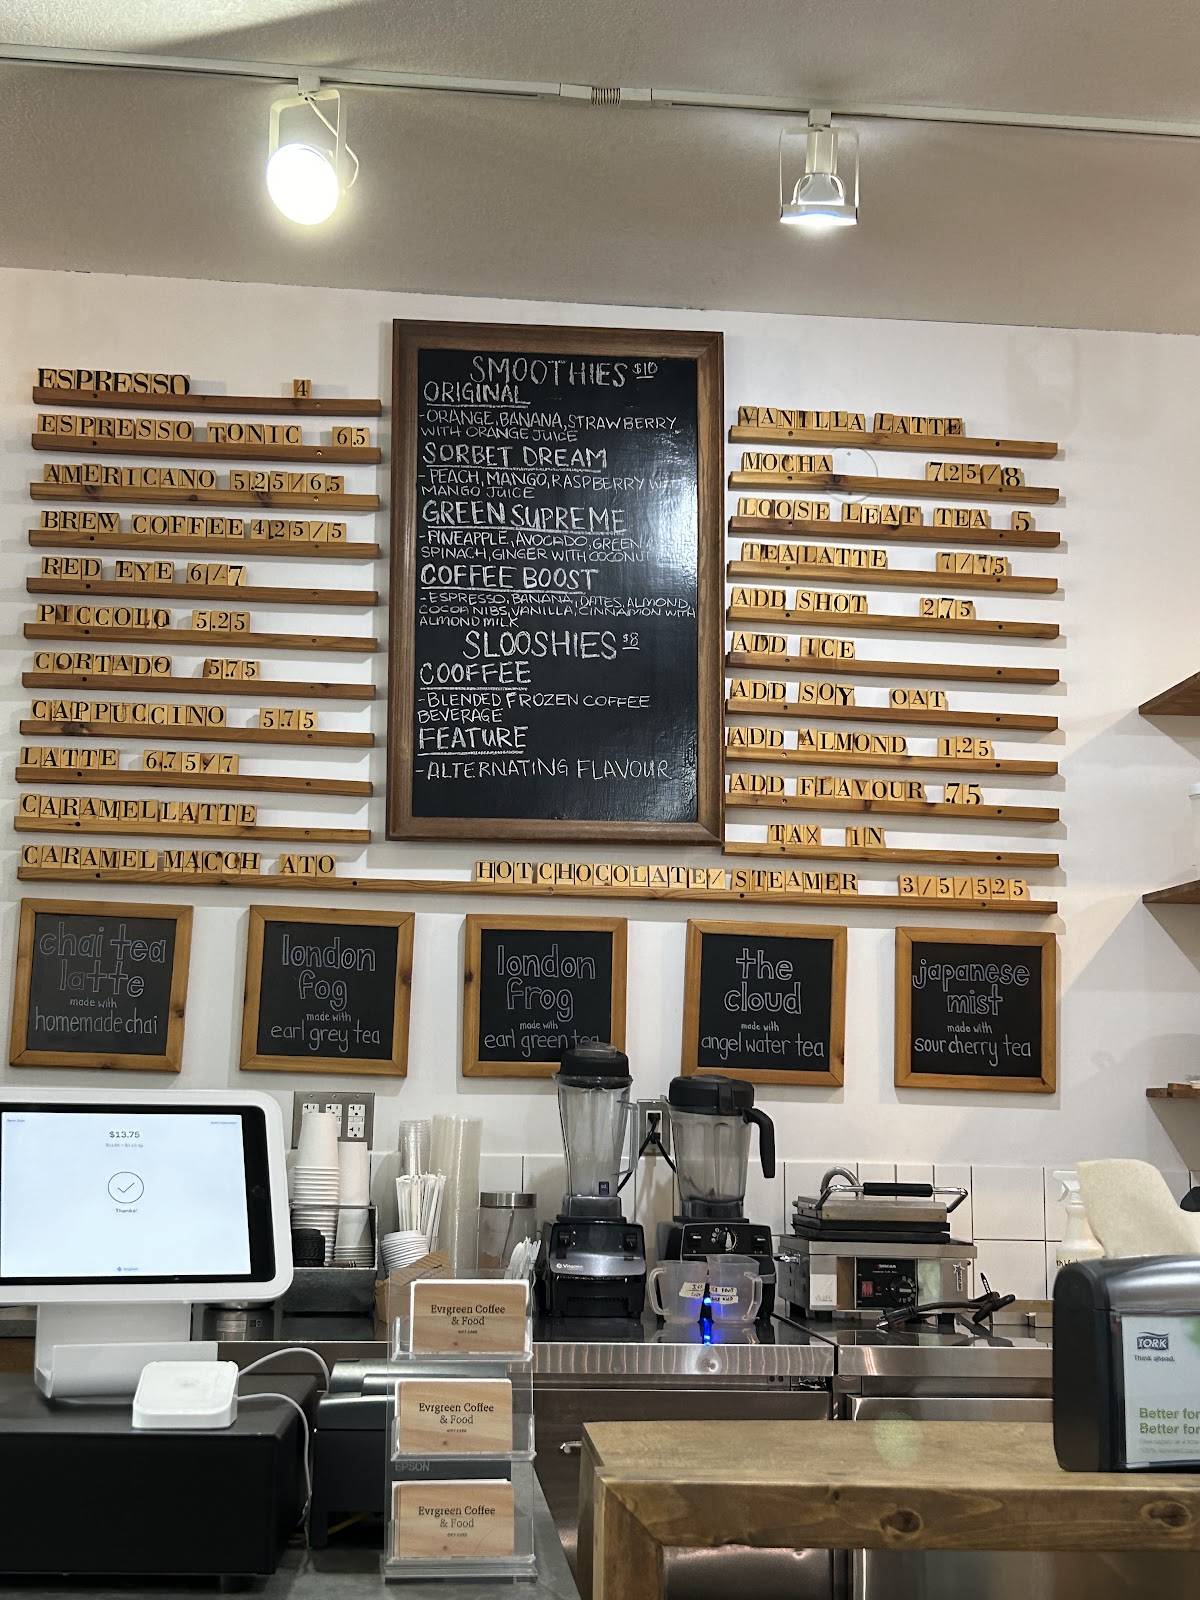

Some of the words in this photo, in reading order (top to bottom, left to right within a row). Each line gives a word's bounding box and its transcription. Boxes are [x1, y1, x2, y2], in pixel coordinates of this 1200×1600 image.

[37, 368, 190, 394] ESPRESSO
[296, 380, 308, 397] 4
[470, 356, 627, 387] SMOOTHIES
[632, 361, 658, 378] $10
[424, 381, 531, 405] ORIGINAL
[41, 415, 192, 439] ESPRESSO
[210, 423, 300, 444] TONIC
[337, 427, 366, 446] 6.5
[568, 415, 677, 430] STRAWBERRY
[742, 407, 864, 431] VANILLA
[878, 415, 961, 435] LATTE
[421, 426, 461, 437] WITH
[466, 426, 529, 439] ORANGE
[532, 429, 578, 442] JUICE
[423, 442, 513, 467] SORBET
[522, 446, 607, 468] DREAM
[46, 464, 215, 488] AMERICANO
[234, 472, 340, 491] 5.25/6.5
[744, 453, 832, 472] MOCHA
[929, 463, 1021, 486] 7.25/8
[421, 485, 481, 497] MANGO
[486, 486, 535, 499] JUICE
[552, 475, 644, 491] RASPBERRY
[43, 512, 119, 531] BREW
[132, 515, 244, 537] COFFEE
[252, 519, 343, 539] 4.25/5
[422, 500, 506, 526] GREEN
[511, 503, 628, 533] SUPREME
[742, 499, 830, 519] LOOSE
[845, 504, 919, 524] LEAF
[937, 509, 986, 527] TEA
[492, 548, 548, 561] GINGER
[552, 550, 586, 563] WITH
[592, 537, 642, 551] GREEN
[43, 557, 101, 577] RED
[116, 561, 172, 581] EYE
[190, 564, 243, 586] 6/7
[420, 563, 517, 589] COFFEE
[523, 567, 599, 590] BOOST
[941, 553, 1005, 575] 7/7.5
[419, 604, 469, 615] COCOA
[578, 606, 661, 617] CINNAMON
[665, 608, 696, 618] WITH
[735, 588, 786, 607] ADD
[800, 591, 867, 613] SHOT
[924, 598, 973, 618] 2.75
[39, 605, 170, 627] PICCOLO
[196, 612, 246, 630] 5.25
[419, 616, 480, 627] ALMOND
[483, 616, 519, 628] MILK
[463, 630, 617, 660] SLOOSHIES
[622, 632, 640, 650] $8
[735, 634, 786, 653] ADD
[806, 638, 855, 659] ICE
[36, 653, 171, 675] CORTADO
[208, 660, 257, 677] 5.75
[420, 660, 531, 685] COOFFEE
[506, 692, 579, 709] FROZEN
[583, 695, 650, 709] COFFEE
[732, 681, 786, 700] ADD
[802, 684, 854, 706] SOY
[892, 689, 944, 708] OAT
[32, 701, 225, 725] CAPPUCCINO
[263, 710, 314, 729] 5.75
[417, 709, 503, 724] BEVERAGE
[419, 726, 529, 750] FEATURE
[731, 728, 784, 748] ADD
[801, 730, 906, 753] ALMOND
[944, 737, 990, 757] 1.25
[22, 748, 117, 768] LATTE
[146, 751, 233, 772] 6.75/7
[577, 759, 673, 780] FLAVOUR
[732, 775, 784, 794] ADD
[800, 778, 923, 799] FLAVOUR
[945, 783, 980, 804] .75
[770, 824, 818, 844] TAX
[24, 846, 156, 870] CARAMEL
[164, 851, 259, 872] MACCH
[280, 855, 335, 874] ATO
[476, 861, 533, 880] HOT
[735, 871, 857, 891] STEAMER
[902, 877, 1024, 897] 3/5/5.25
[39, 922, 105, 958] chai
[110, 923, 167, 963] tea
[282, 934, 376, 972] london
[497, 944, 596, 980] london
[735, 948, 794, 981] the
[59, 959, 145, 998] latte
[912, 958, 1031, 993] japanese
[70, 997, 96, 1008] made
[98, 998, 117, 1009] with
[299, 969, 347, 1012] fog
[506, 977, 573, 1023] frog
[724, 982, 802, 1015] cloud
[947, 983, 1004, 1016] mist
[34, 1007, 122, 1033] homemade
[125, 1008, 158, 1035] chai
[306, 1011, 331, 1022] made
[332, 1012, 351, 1023] with
[519, 1020, 541, 1030] made
[542, 1019, 559, 1030] with
[741, 1021, 761, 1032] made
[762, 1020, 780, 1032] with
[947, 1021, 971, 1033] made
[973, 1021, 993, 1034] with
[271, 1021, 305, 1040] earl
[310, 1027, 349, 1053] grey
[354, 1020, 381, 1045] tea
[484, 1032, 516, 1050] earl
[521, 1032, 569, 1057] green
[701, 1032, 743, 1060] angel
[745, 1036, 791, 1055] water
[795, 1032, 825, 1058] tea
[914, 1038, 947, 1053] sour
[948, 1034, 999, 1067] cherry
[1003, 1034, 1031, 1057] tea
[108, 1131, 140, 1139] $13.75
[431, 1304, 473, 1316] Evrgreen
[475, 1303, 505, 1315] Coffee
[451, 1316, 460, 1326] &
[462, 1315, 485, 1326] Food
[1138, 1338, 1167, 1349] TORK
[419, 1402, 461, 1414] Evrgreen
[463, 1402, 494, 1413] Coffee
[440, 1415, 449, 1424] &
[450, 1414, 474, 1425] Food
[1139, 1408, 1179, 1419] Better
[1139, 1422, 1179, 1434] Better
[418, 1505, 462, 1517] Evrgreen
[464, 1505, 496, 1516] Coffee
[440, 1518, 449, 1528] &
[450, 1518, 475, 1529] Food
